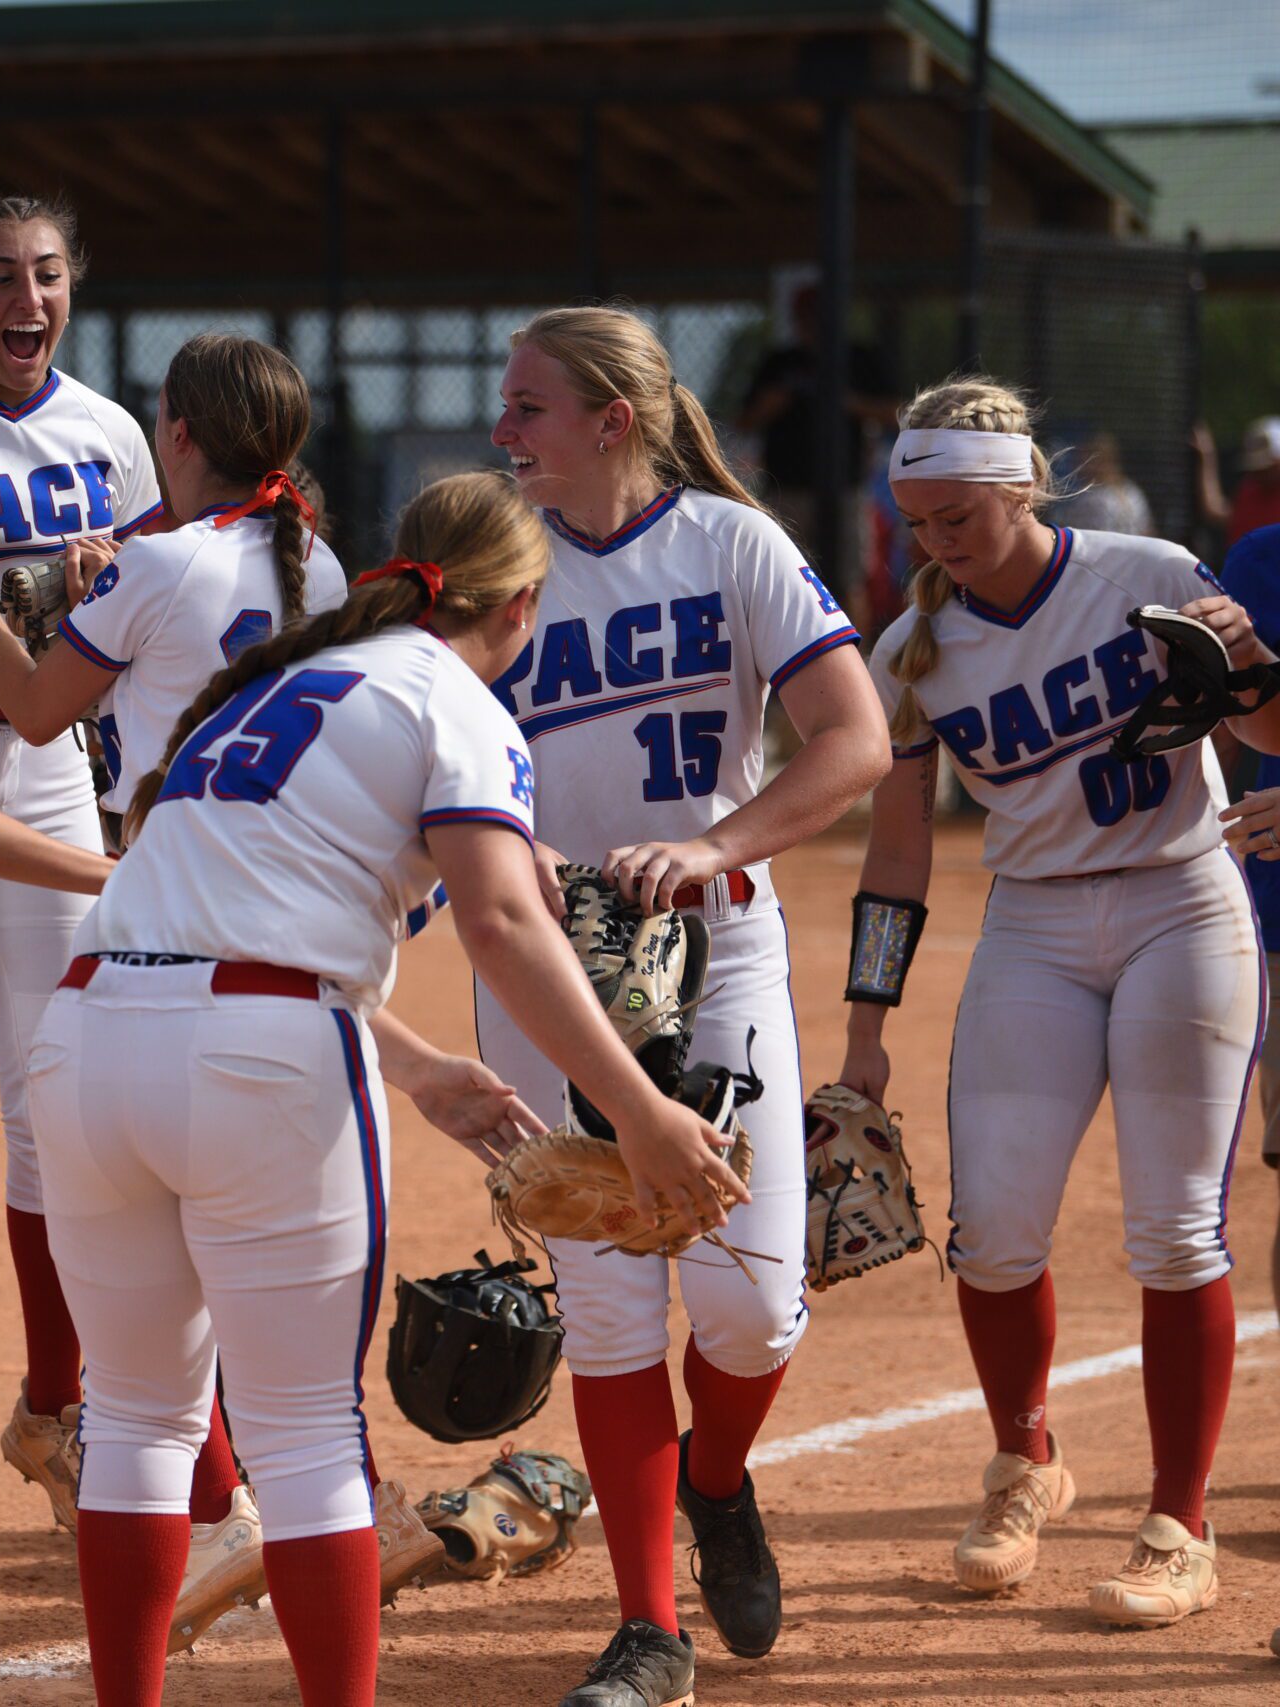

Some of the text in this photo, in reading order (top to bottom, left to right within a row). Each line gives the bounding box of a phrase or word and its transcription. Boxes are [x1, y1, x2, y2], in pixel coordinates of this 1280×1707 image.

[929, 627, 1161, 770] PACE
[633, 710, 728, 803] 15
[628, 992, 644, 1010] 10
